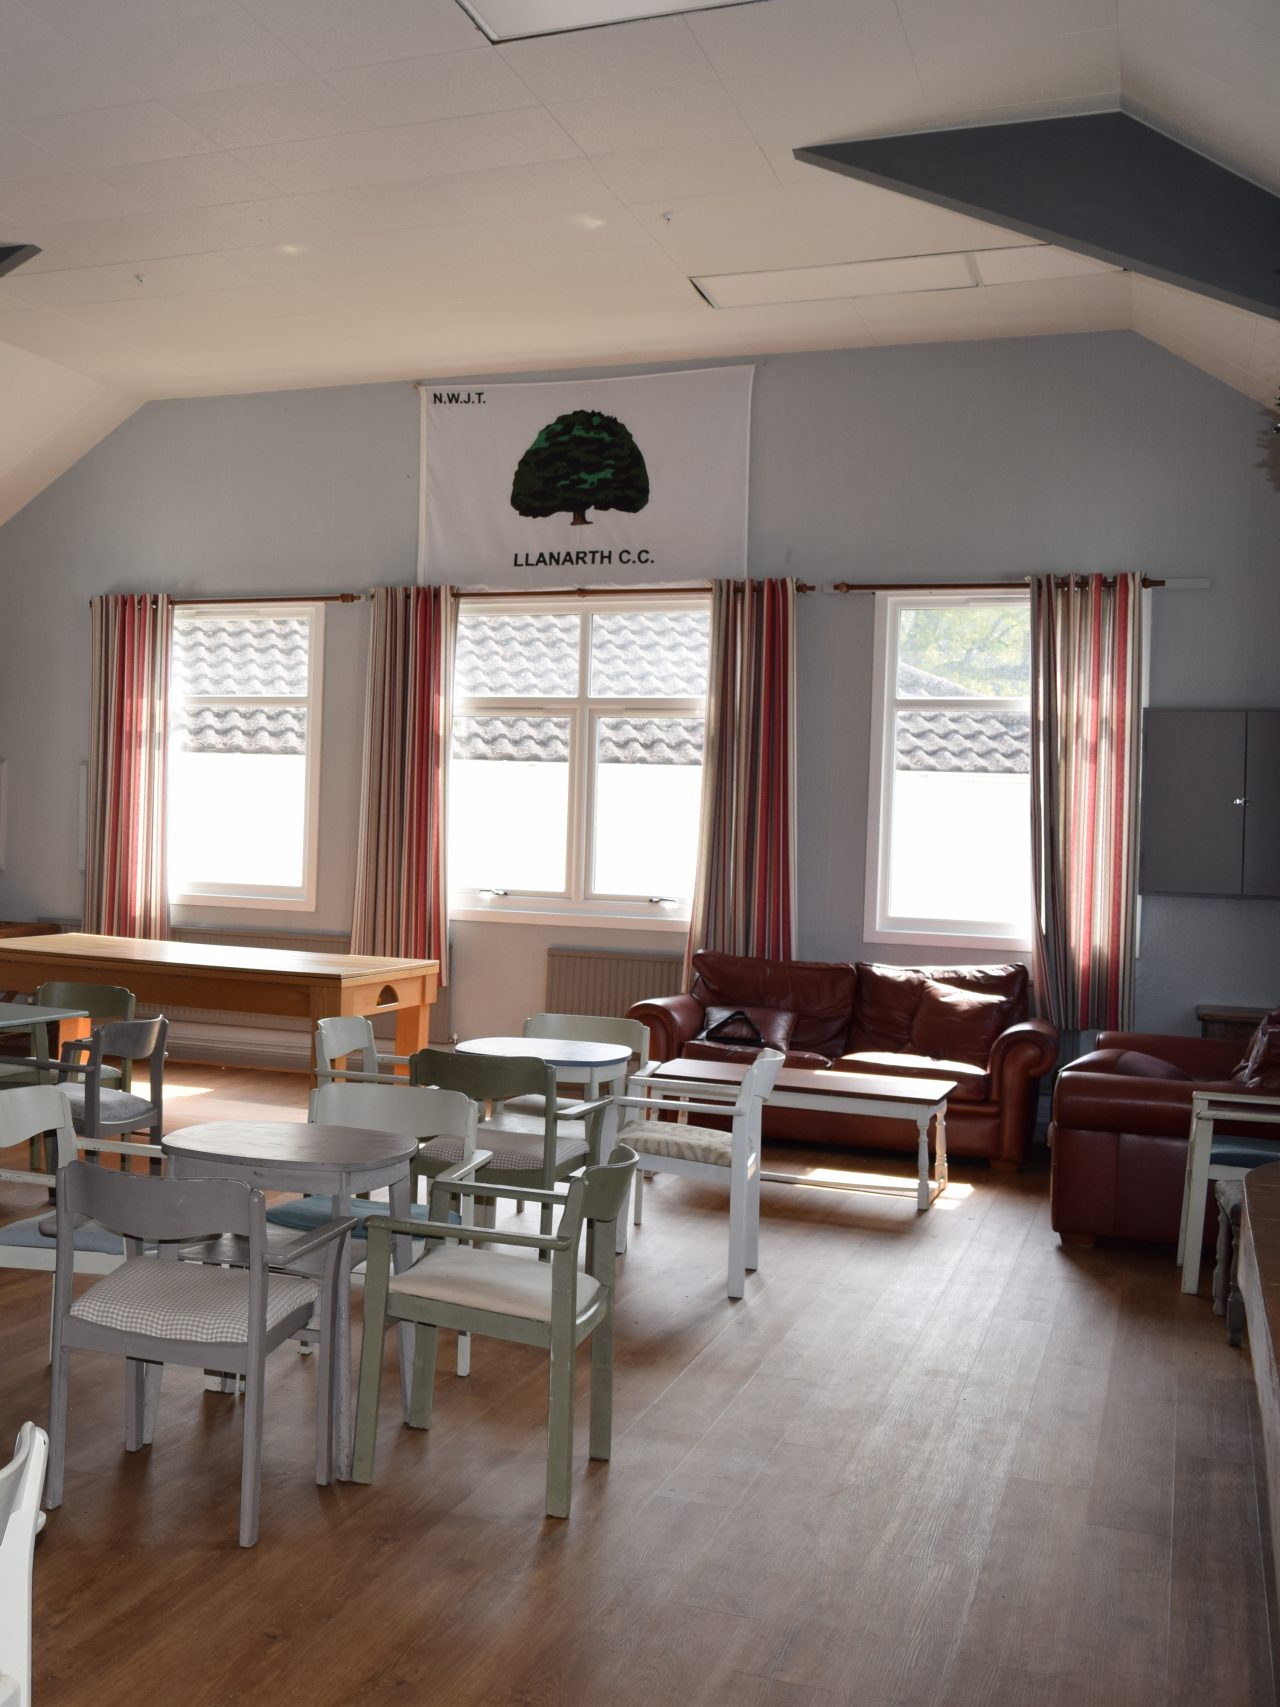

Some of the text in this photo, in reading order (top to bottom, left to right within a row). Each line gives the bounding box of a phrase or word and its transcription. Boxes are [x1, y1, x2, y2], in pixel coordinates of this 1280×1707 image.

[433, 392, 486, 404] N.W.J.T.
[513, 549, 655, 567] LLANARTH C.C.
